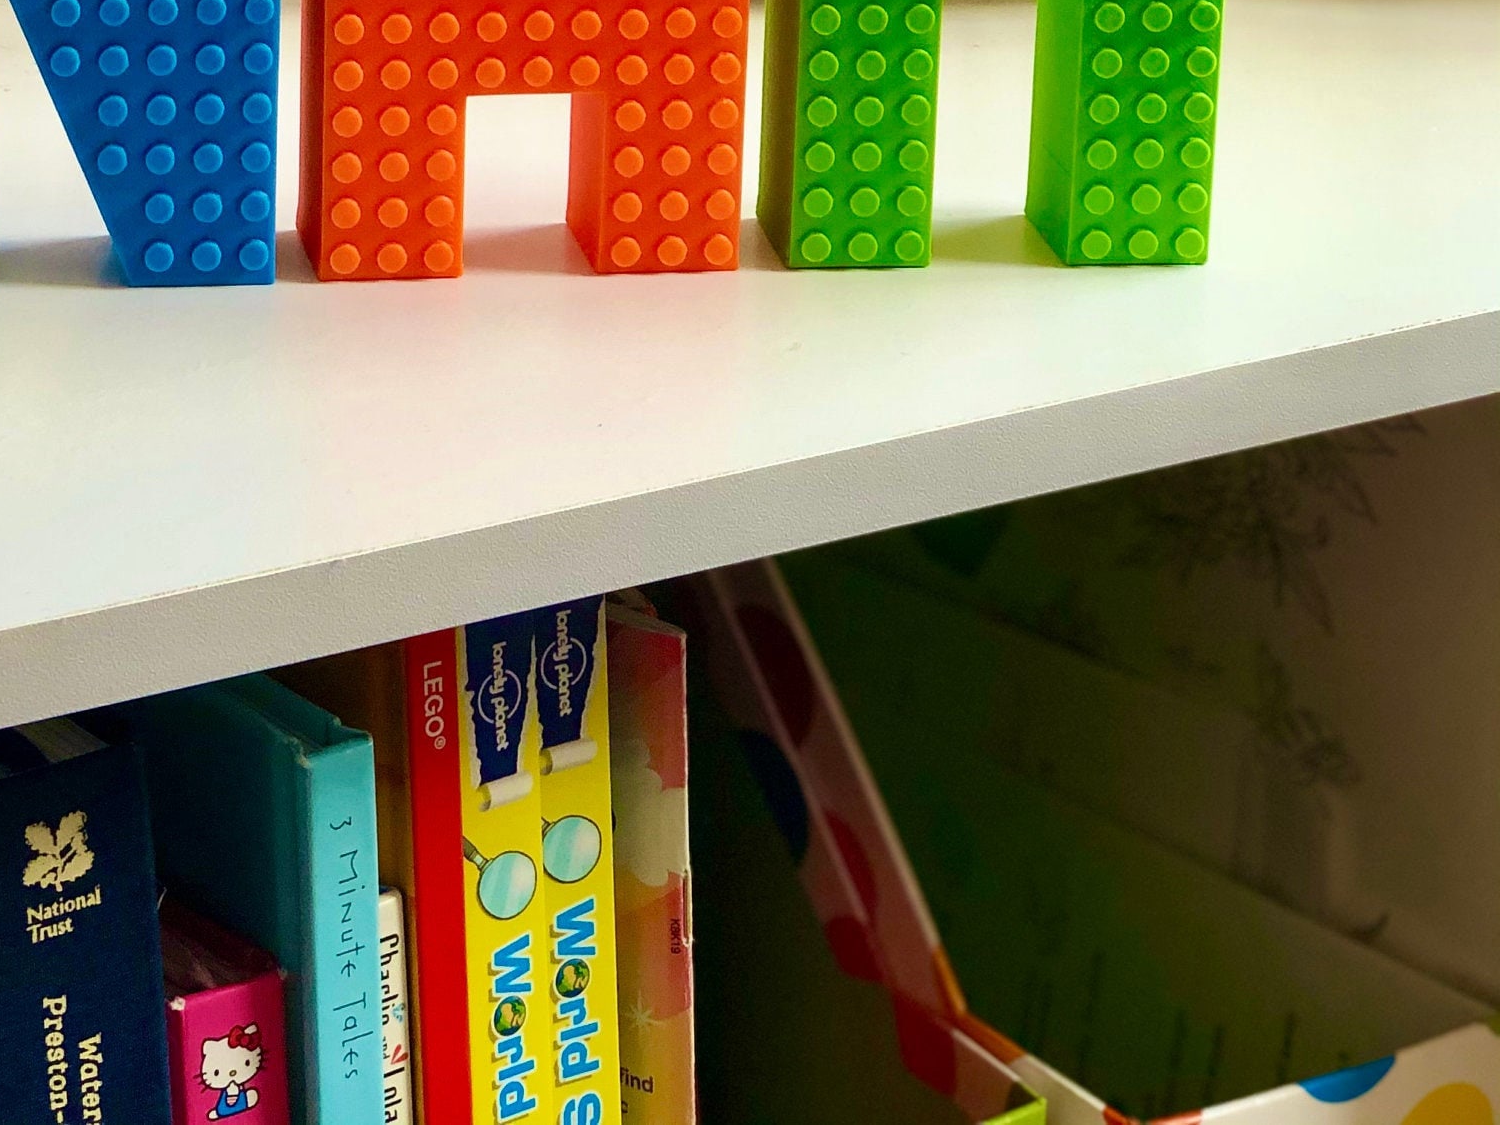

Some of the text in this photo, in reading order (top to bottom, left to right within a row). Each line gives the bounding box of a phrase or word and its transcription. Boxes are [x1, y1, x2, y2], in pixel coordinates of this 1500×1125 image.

[489, 641, 510, 753] lonely planet
[553, 609, 573, 718] lonely planet
[330, 816, 353, 831] 3
[26, 884, 102, 925] National
[26, 917, 74, 944] Trust
[333, 992, 374, 1079] Tales
[493, 932, 537, 1120] World
[555, 896, 601, 1082] World
[78, 1031, 104, 1125] Water
